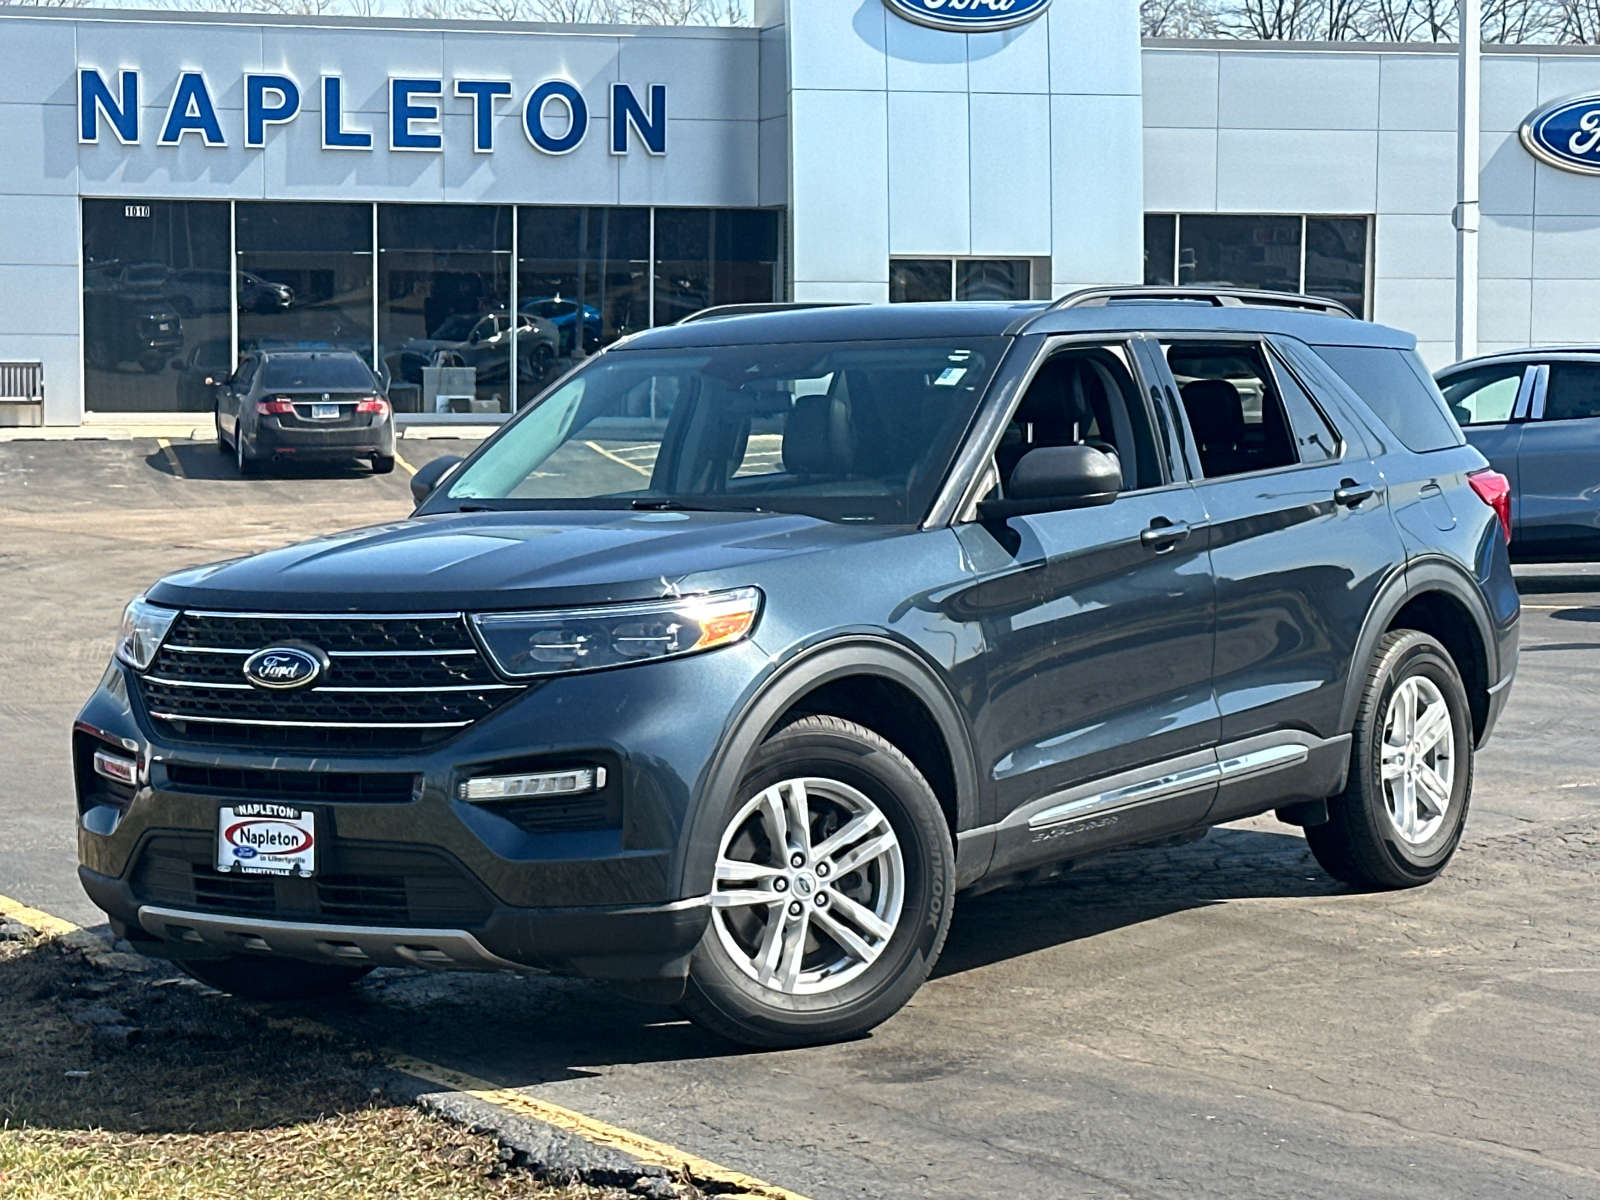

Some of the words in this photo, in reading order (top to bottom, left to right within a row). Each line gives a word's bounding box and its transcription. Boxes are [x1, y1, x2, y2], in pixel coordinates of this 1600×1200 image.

[77, 67, 669, 156] NAPLETON
[125, 205, 150, 217] 1010
[259, 656, 299, 678] Ford
[238, 804, 295, 818] NAPLETON
[240, 828, 299, 848] Napleton
[241, 867, 291, 876] LIBERTYVILLE
